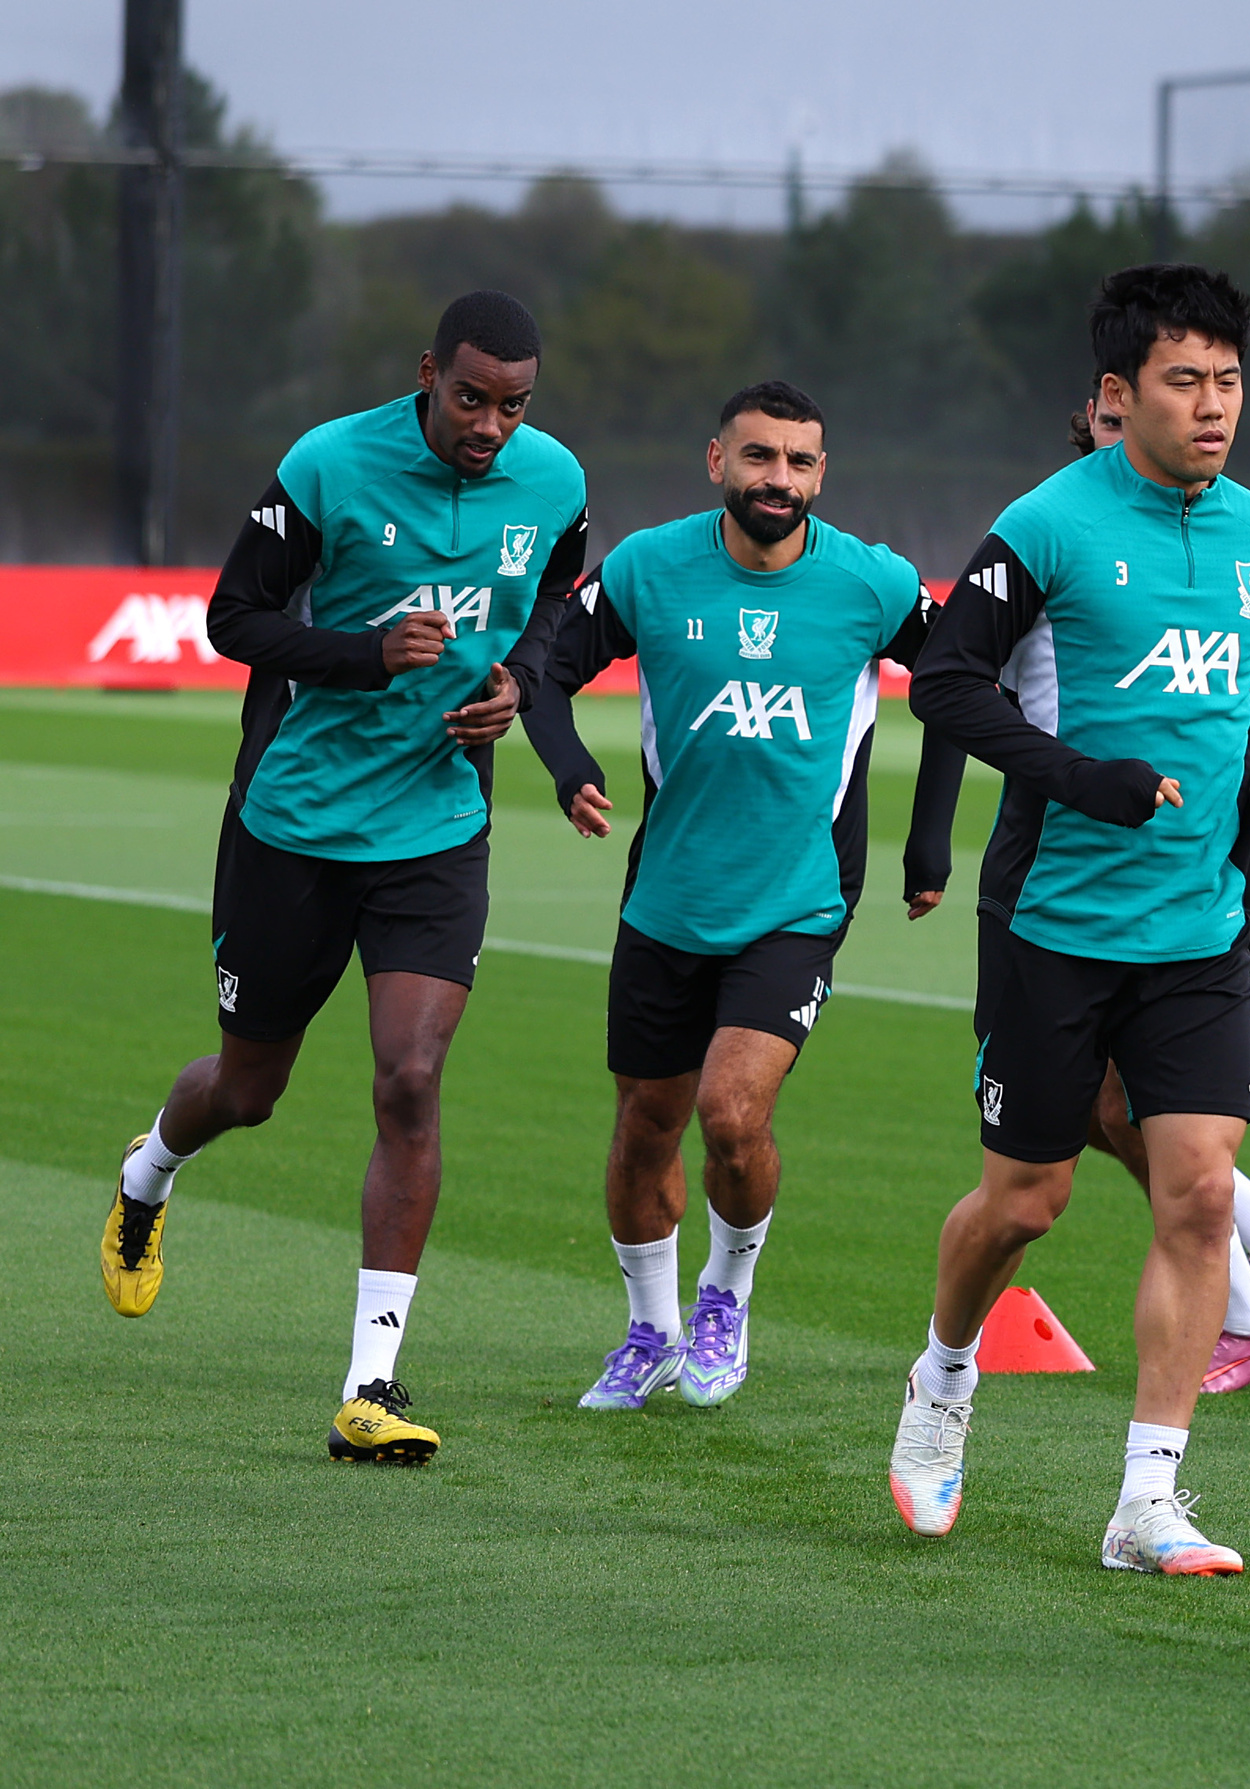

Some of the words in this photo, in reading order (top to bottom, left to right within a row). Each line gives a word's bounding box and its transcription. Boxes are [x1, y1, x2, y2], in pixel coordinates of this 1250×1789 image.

[382, 522, 397, 546] 9
[1115, 560, 1128, 586] 3
[365, 584, 493, 639] AXA
[88, 593, 221, 664] AXA
[687, 618, 704, 640] 11
[1114, 628, 1240, 695] AXA
[689, 680, 812, 741] AXA
[813, 976, 824, 1002] 11
[709, 1366, 748, 1399] F50
[348, 1416, 382, 1434] F50
